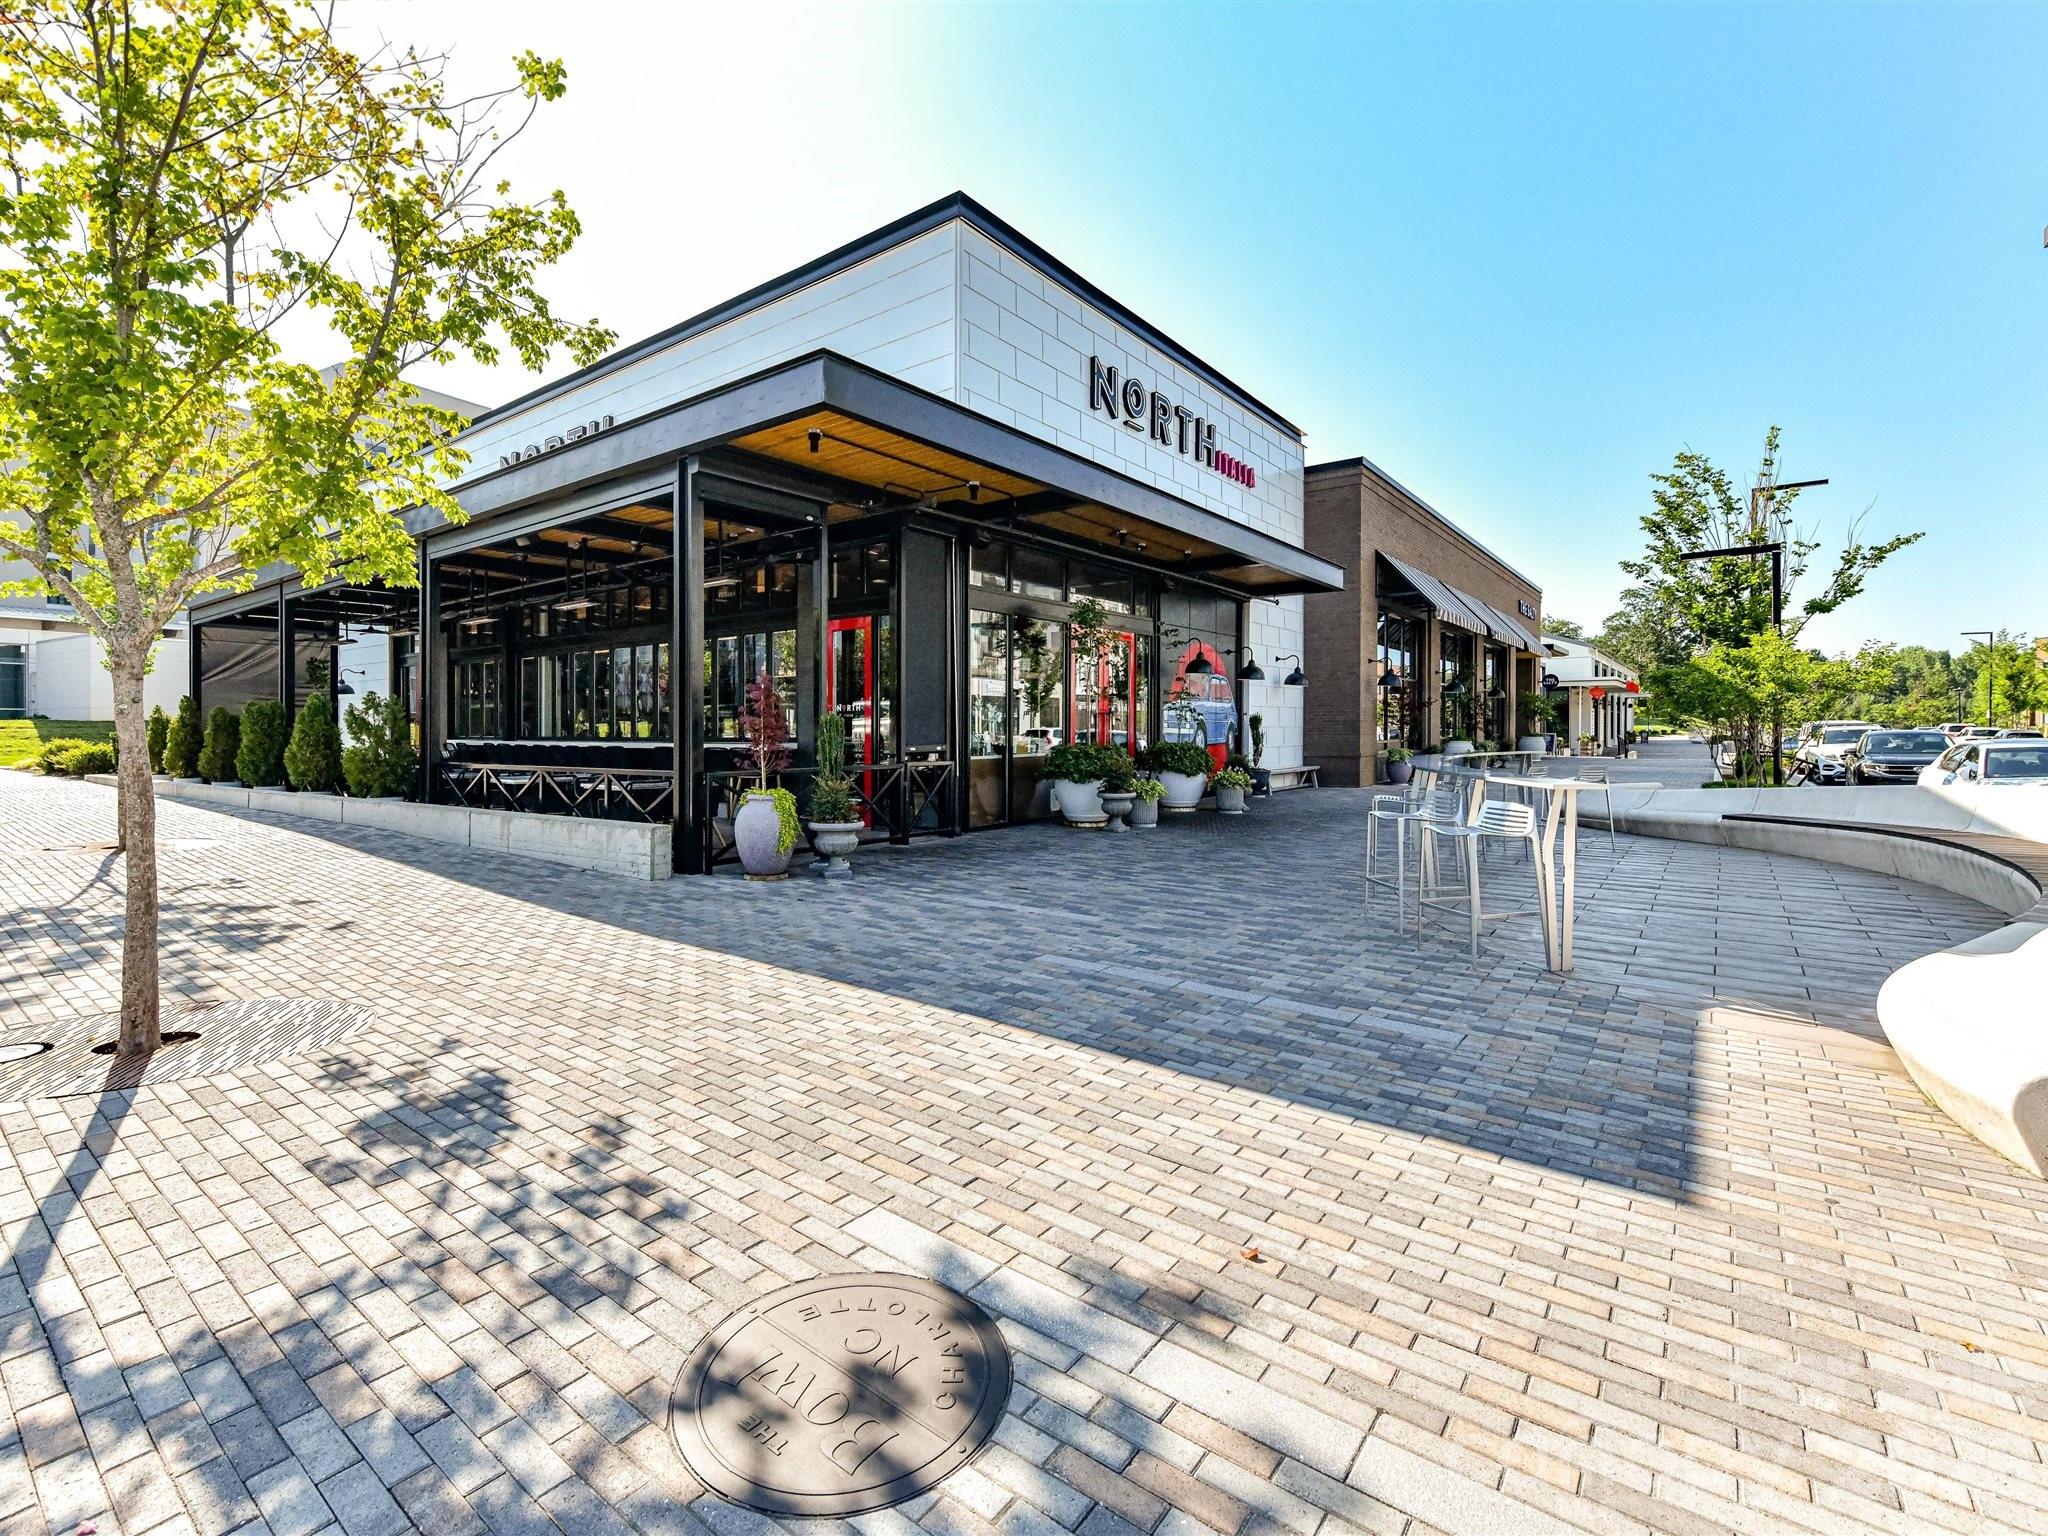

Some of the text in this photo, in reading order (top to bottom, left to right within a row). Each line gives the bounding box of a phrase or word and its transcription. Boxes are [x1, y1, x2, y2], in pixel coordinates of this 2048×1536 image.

[1090, 355, 1216, 467] NORTH
[1215, 450, 1255, 488] ITALIA
[836, 703, 861, 711] NORTH
[797, 1297, 964, 1410] CHARLOTTE
[839, 1327, 919, 1380] NC
[738, 1414, 790, 1456] THE
